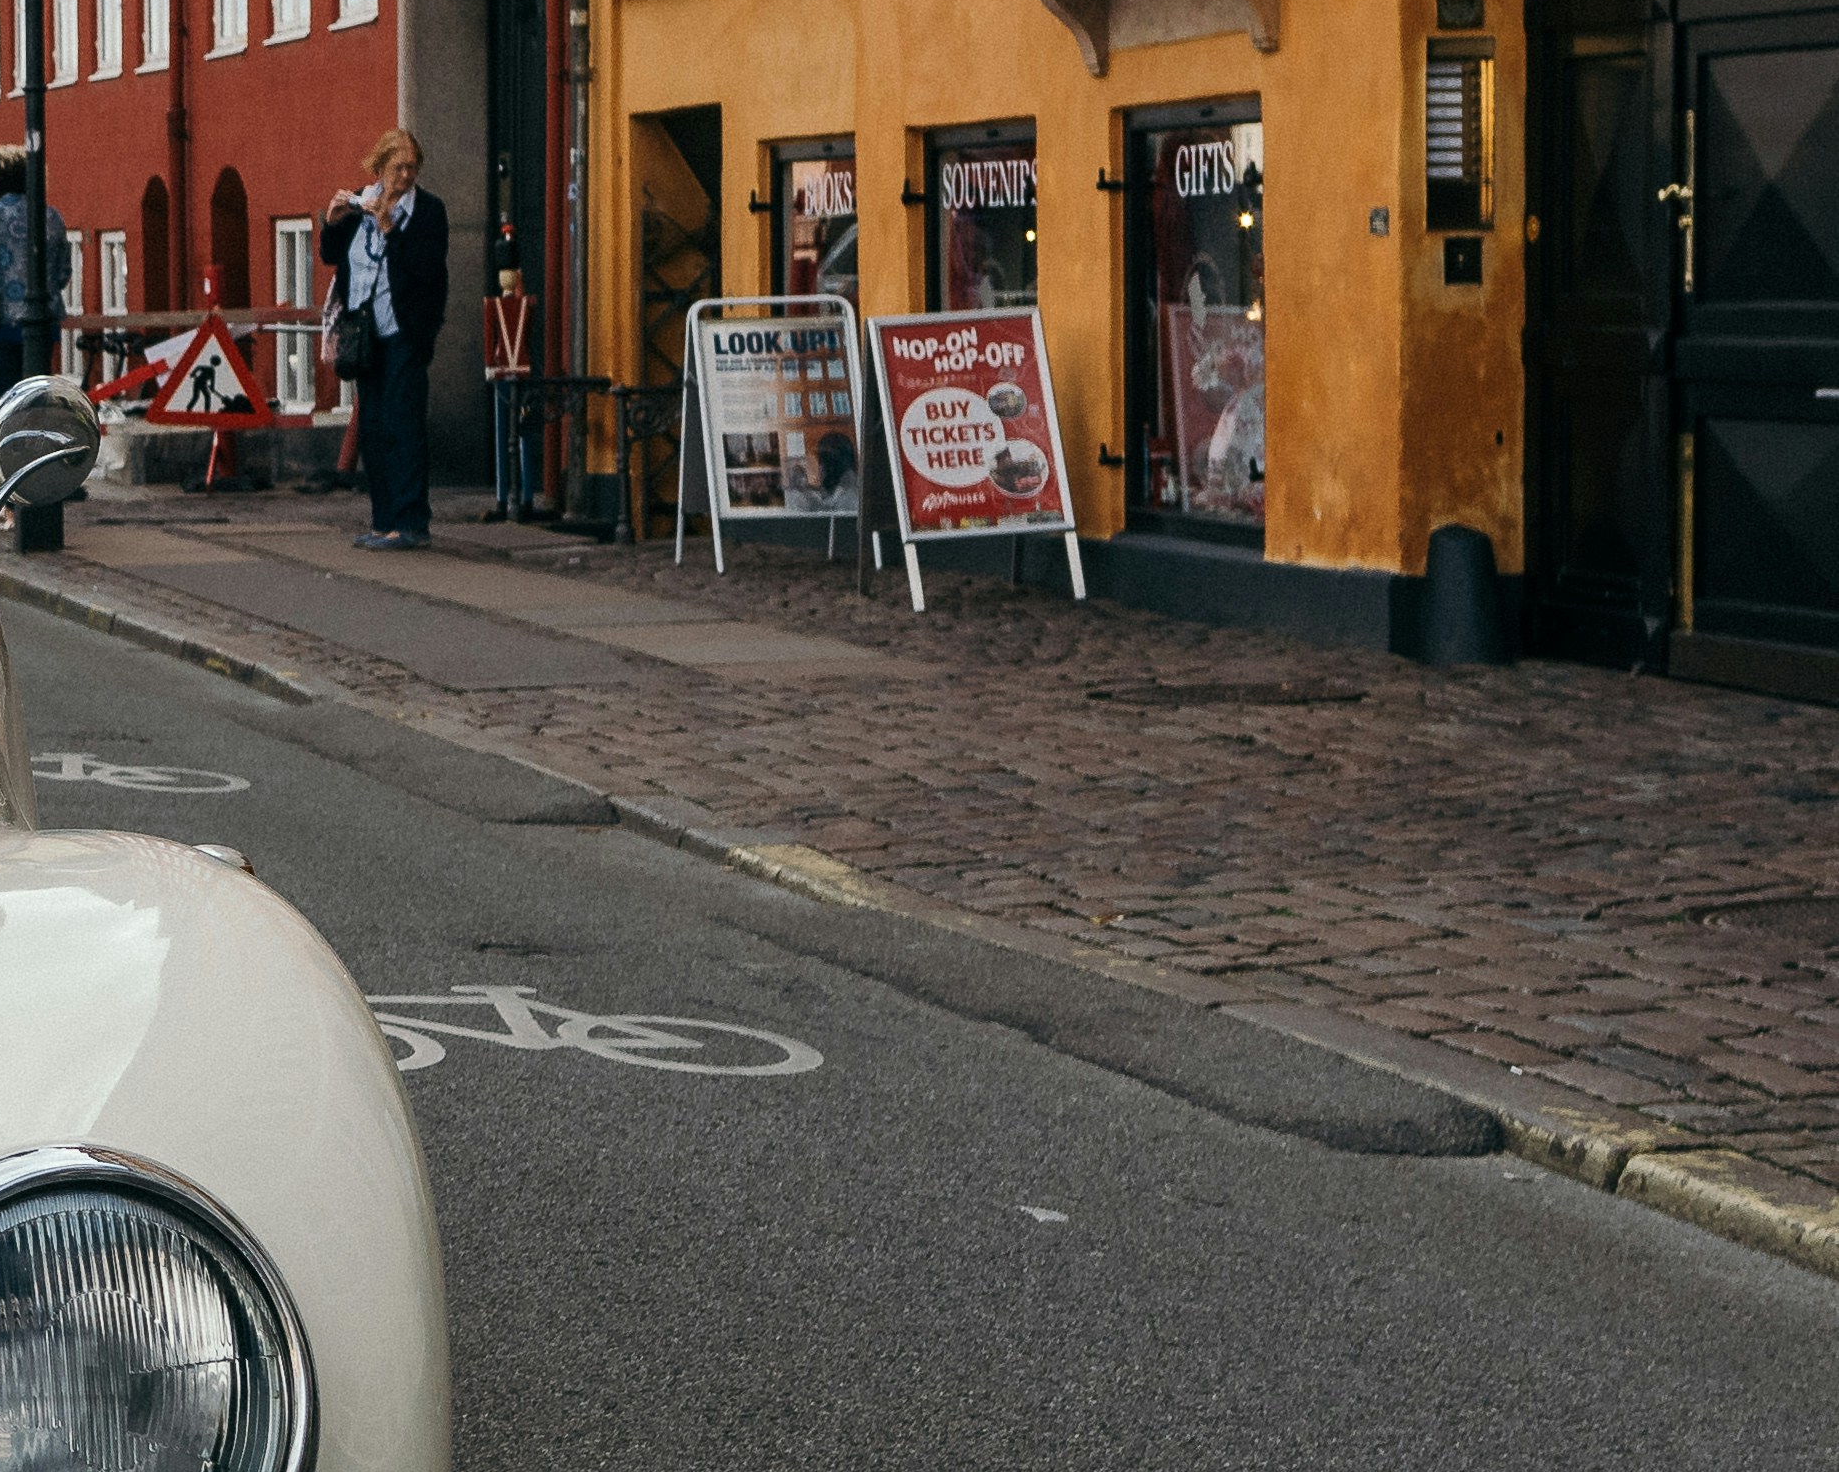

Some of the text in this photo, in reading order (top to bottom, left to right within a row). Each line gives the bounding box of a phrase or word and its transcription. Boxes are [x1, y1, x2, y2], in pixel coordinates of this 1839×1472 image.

[1175, 140, 1235, 198] GIFTS
[803, 170, 854, 216] BOOKS
[713, 329, 838, 355] LOOK UP!
[892, 326, 978, 361] HOP-ON
[933, 341, 1025, 373] HOP-OFF
[925, 400, 971, 421] BUY
[906, 422, 997, 447] TICKETS
[926, 447, 986, 469] HERE
